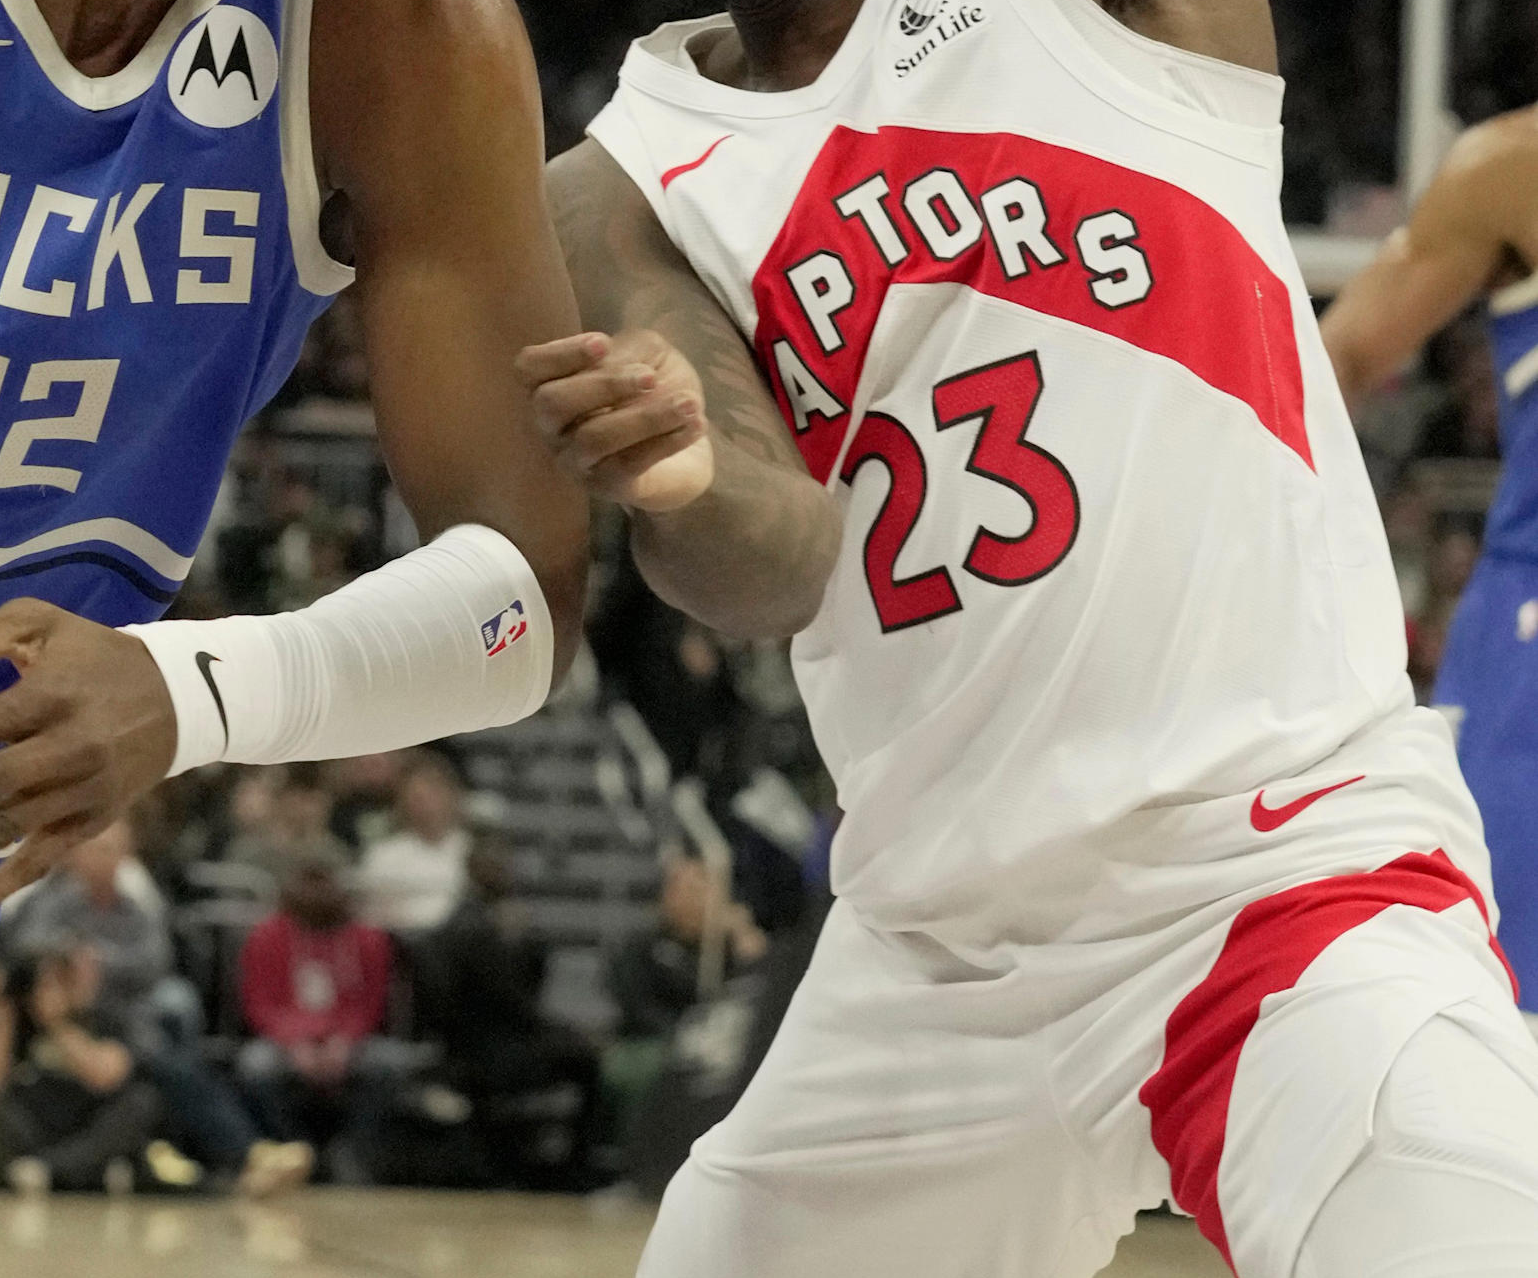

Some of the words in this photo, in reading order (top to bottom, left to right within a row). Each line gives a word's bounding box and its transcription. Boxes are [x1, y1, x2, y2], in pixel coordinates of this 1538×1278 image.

[894, 36, 937, 78] Sun
[936, 5, 986, 42] Life
[773, 167, 1154, 434] APTORS
[840, 350, 1081, 634] 23
[482, 624, 496, 646] NBA
